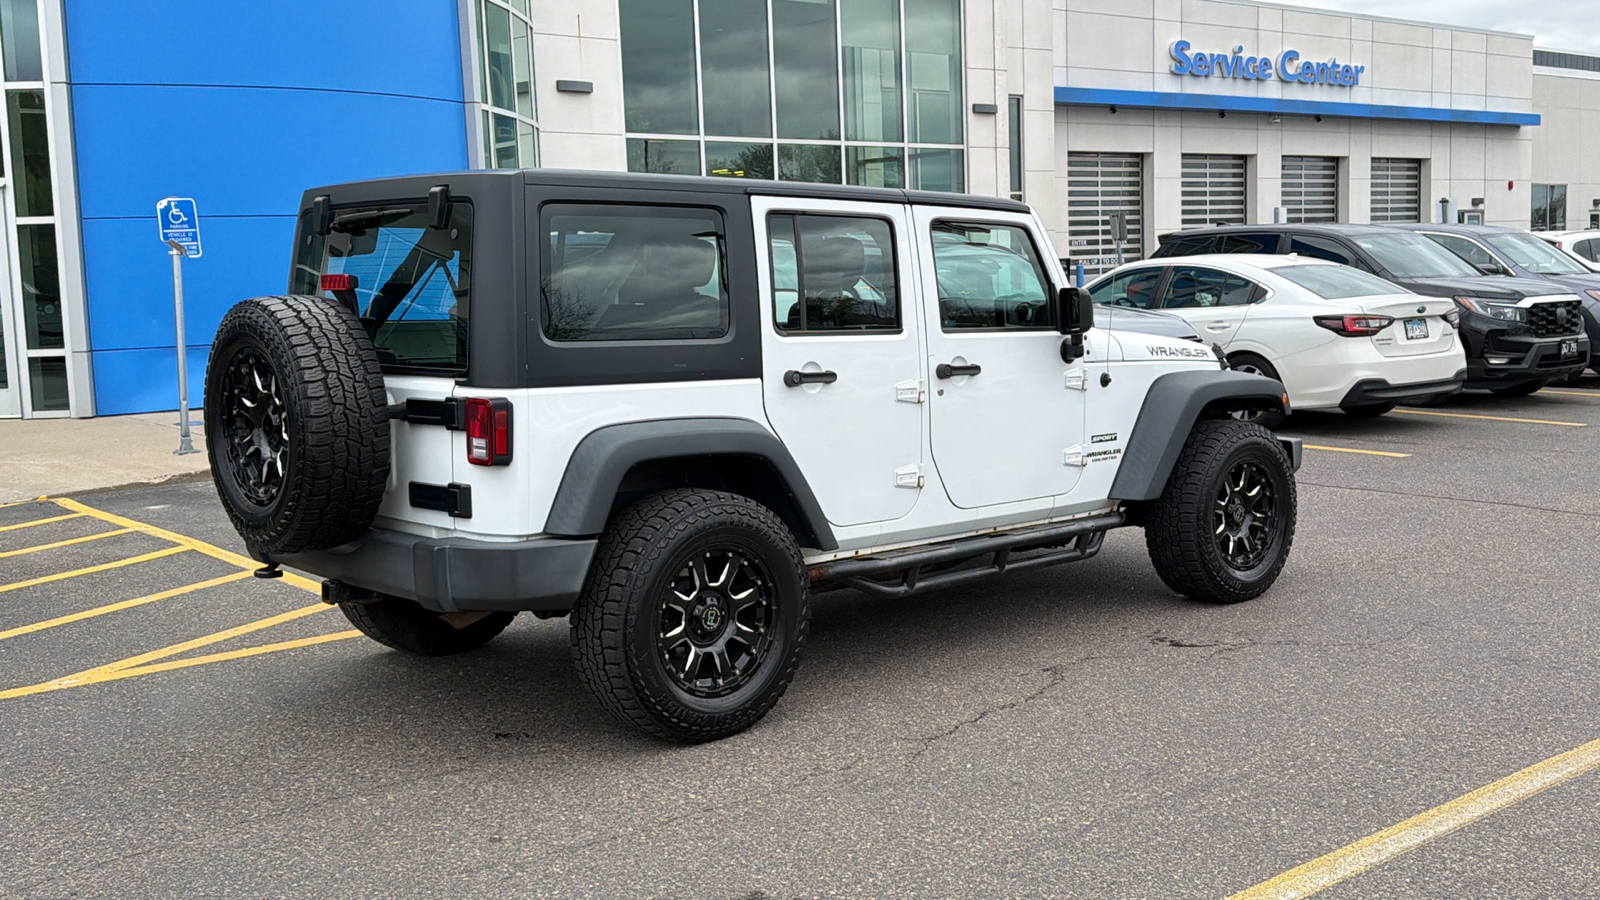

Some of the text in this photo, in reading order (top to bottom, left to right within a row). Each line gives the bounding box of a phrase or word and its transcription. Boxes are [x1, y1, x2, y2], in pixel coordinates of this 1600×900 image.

[1172, 40, 1365, 86] Service Center
[1146, 345, 1209, 358] WRANGLER
[1092, 434, 1116, 442] SPORT
[1086, 449, 1122, 457] WRANGLER
